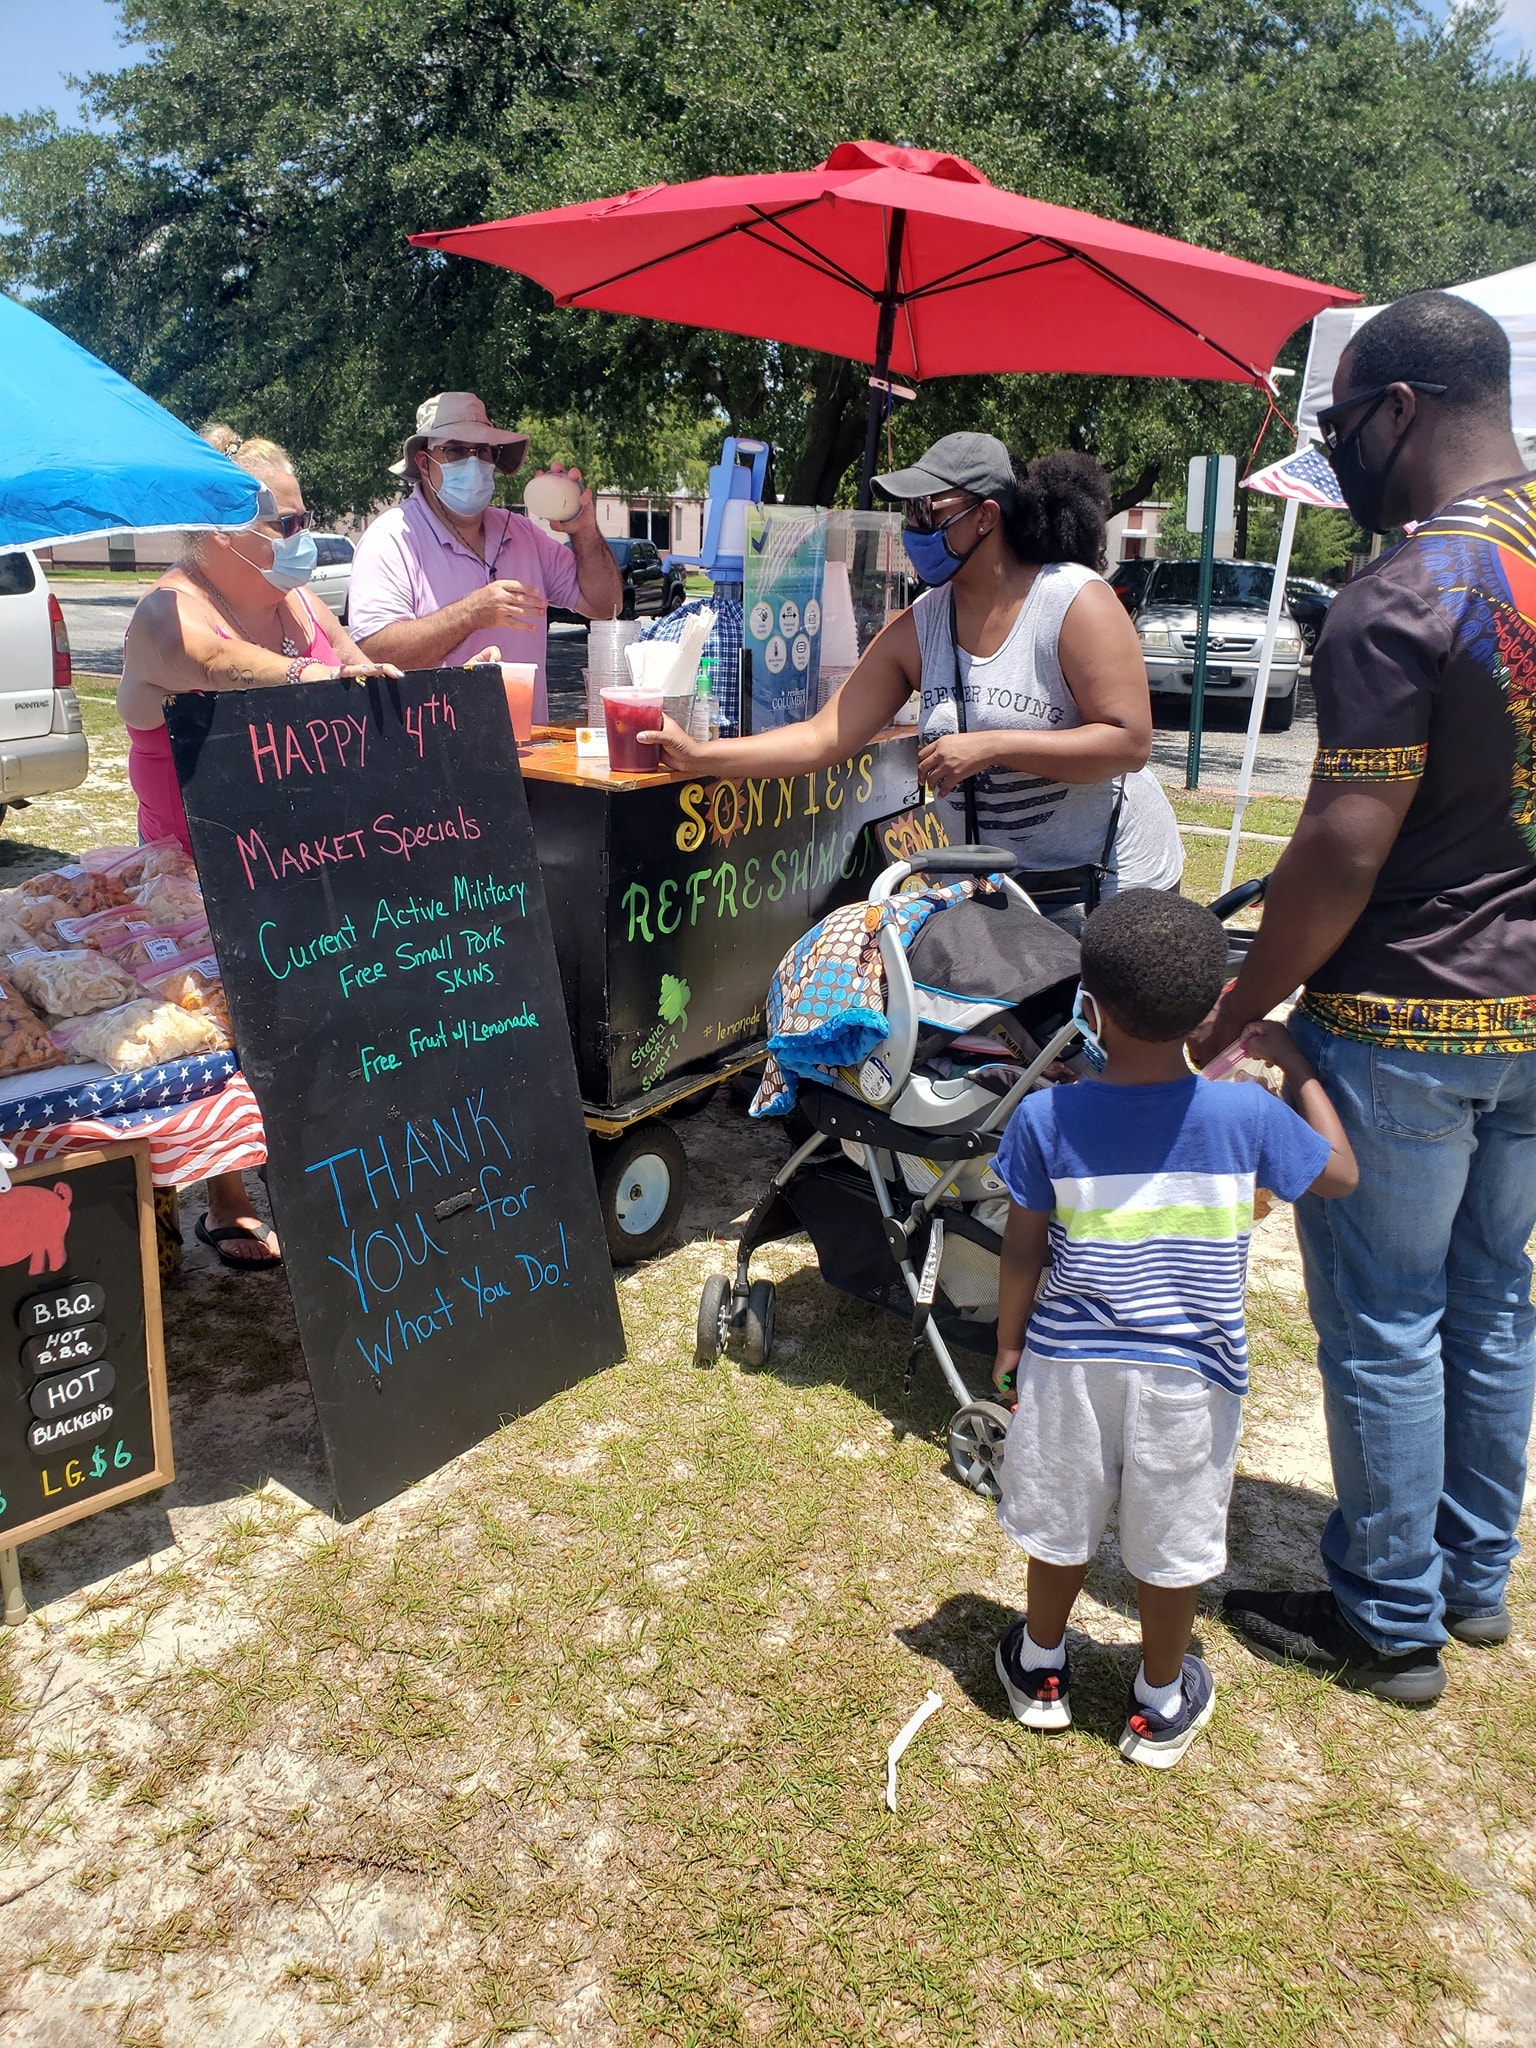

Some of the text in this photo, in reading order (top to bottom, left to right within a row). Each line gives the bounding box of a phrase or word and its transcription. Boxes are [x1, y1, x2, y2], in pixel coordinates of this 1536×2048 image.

[15, 700, 49, 710] PONTIAC
[247, 693, 457, 784] HAPPY 4th
[987, 687, 1065, 725] YOUNG
[675, 753, 873, 852] SONNIE'S
[235, 806, 481, 890] MARKET Specials
[258, 875, 527, 981] Current Active Military
[339, 926, 506, 998] Free Small Pork
[436, 962, 495, 994] SKINS
[360, 1046, 402, 1082] Free
[409, 1020, 449, 1058] Fruit
[305, 1087, 512, 1228] THANK
[327, 1165, 536, 1314] YOU for
[356, 1221, 570, 1374] What You Do!
[45, 1328, 86, 1349] HOT
[47, 1367, 101, 1409] HOT
